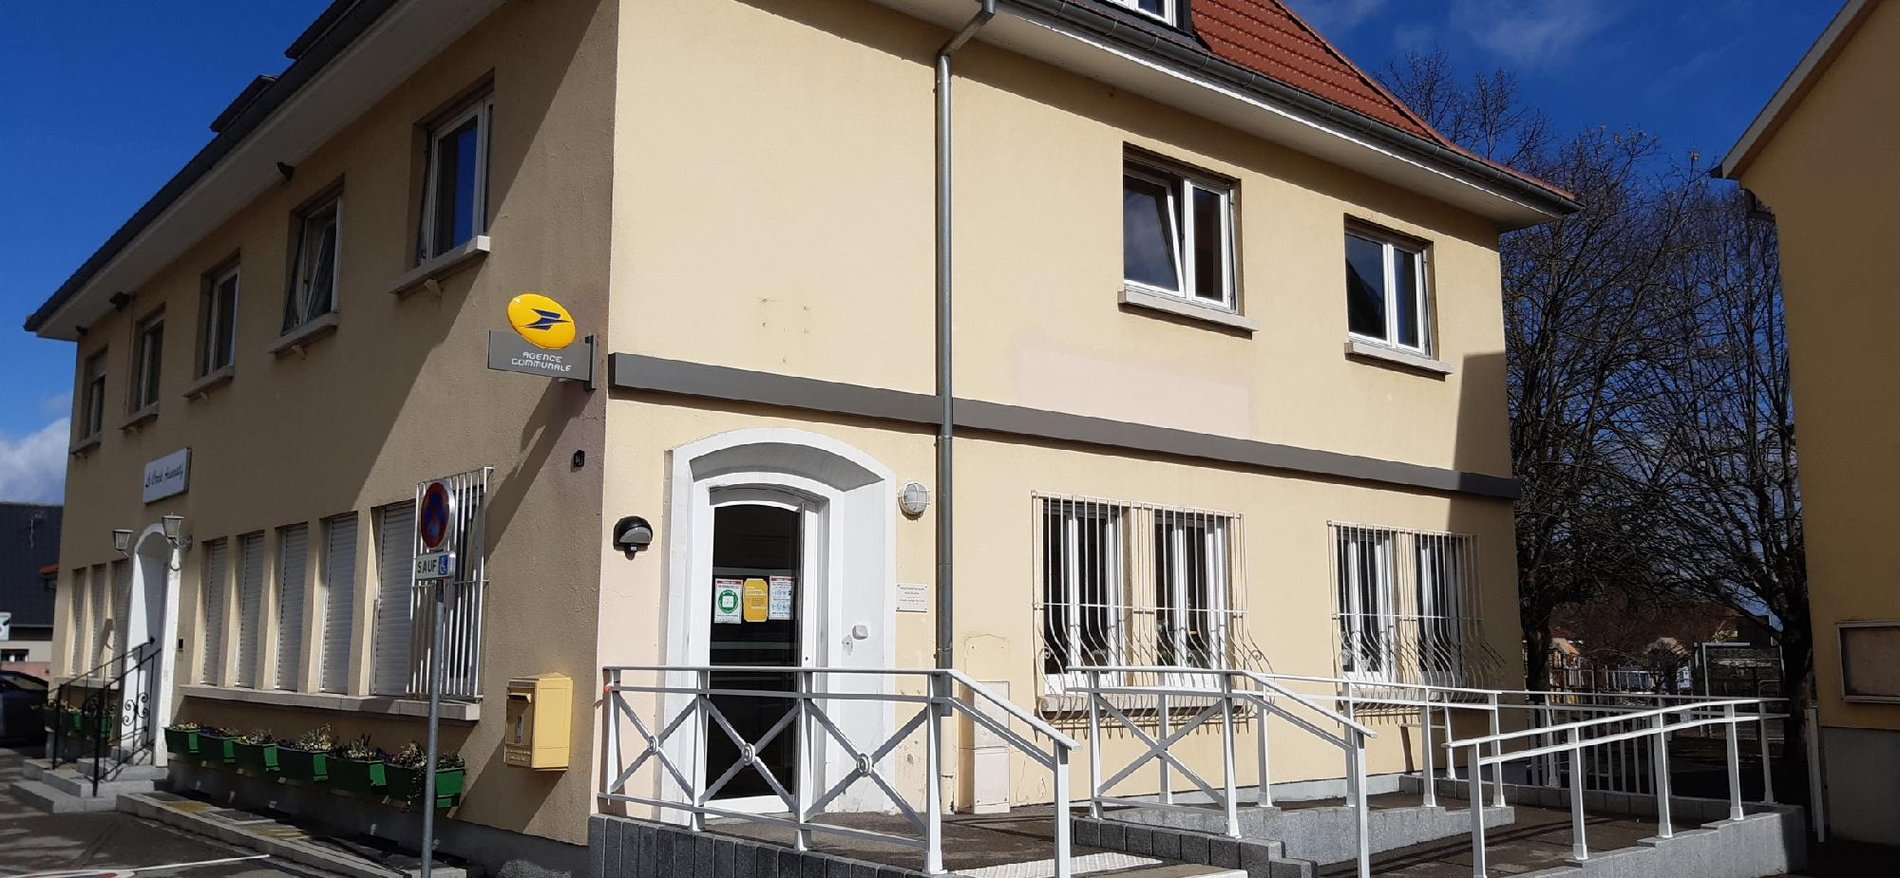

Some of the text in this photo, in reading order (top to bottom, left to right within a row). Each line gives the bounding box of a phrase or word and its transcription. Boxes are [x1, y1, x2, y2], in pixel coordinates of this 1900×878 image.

[522, 351, 563, 363] AGENCE
[511, 358, 572, 372] COMMUNALE
[417, 560, 437, 574] SAUF
